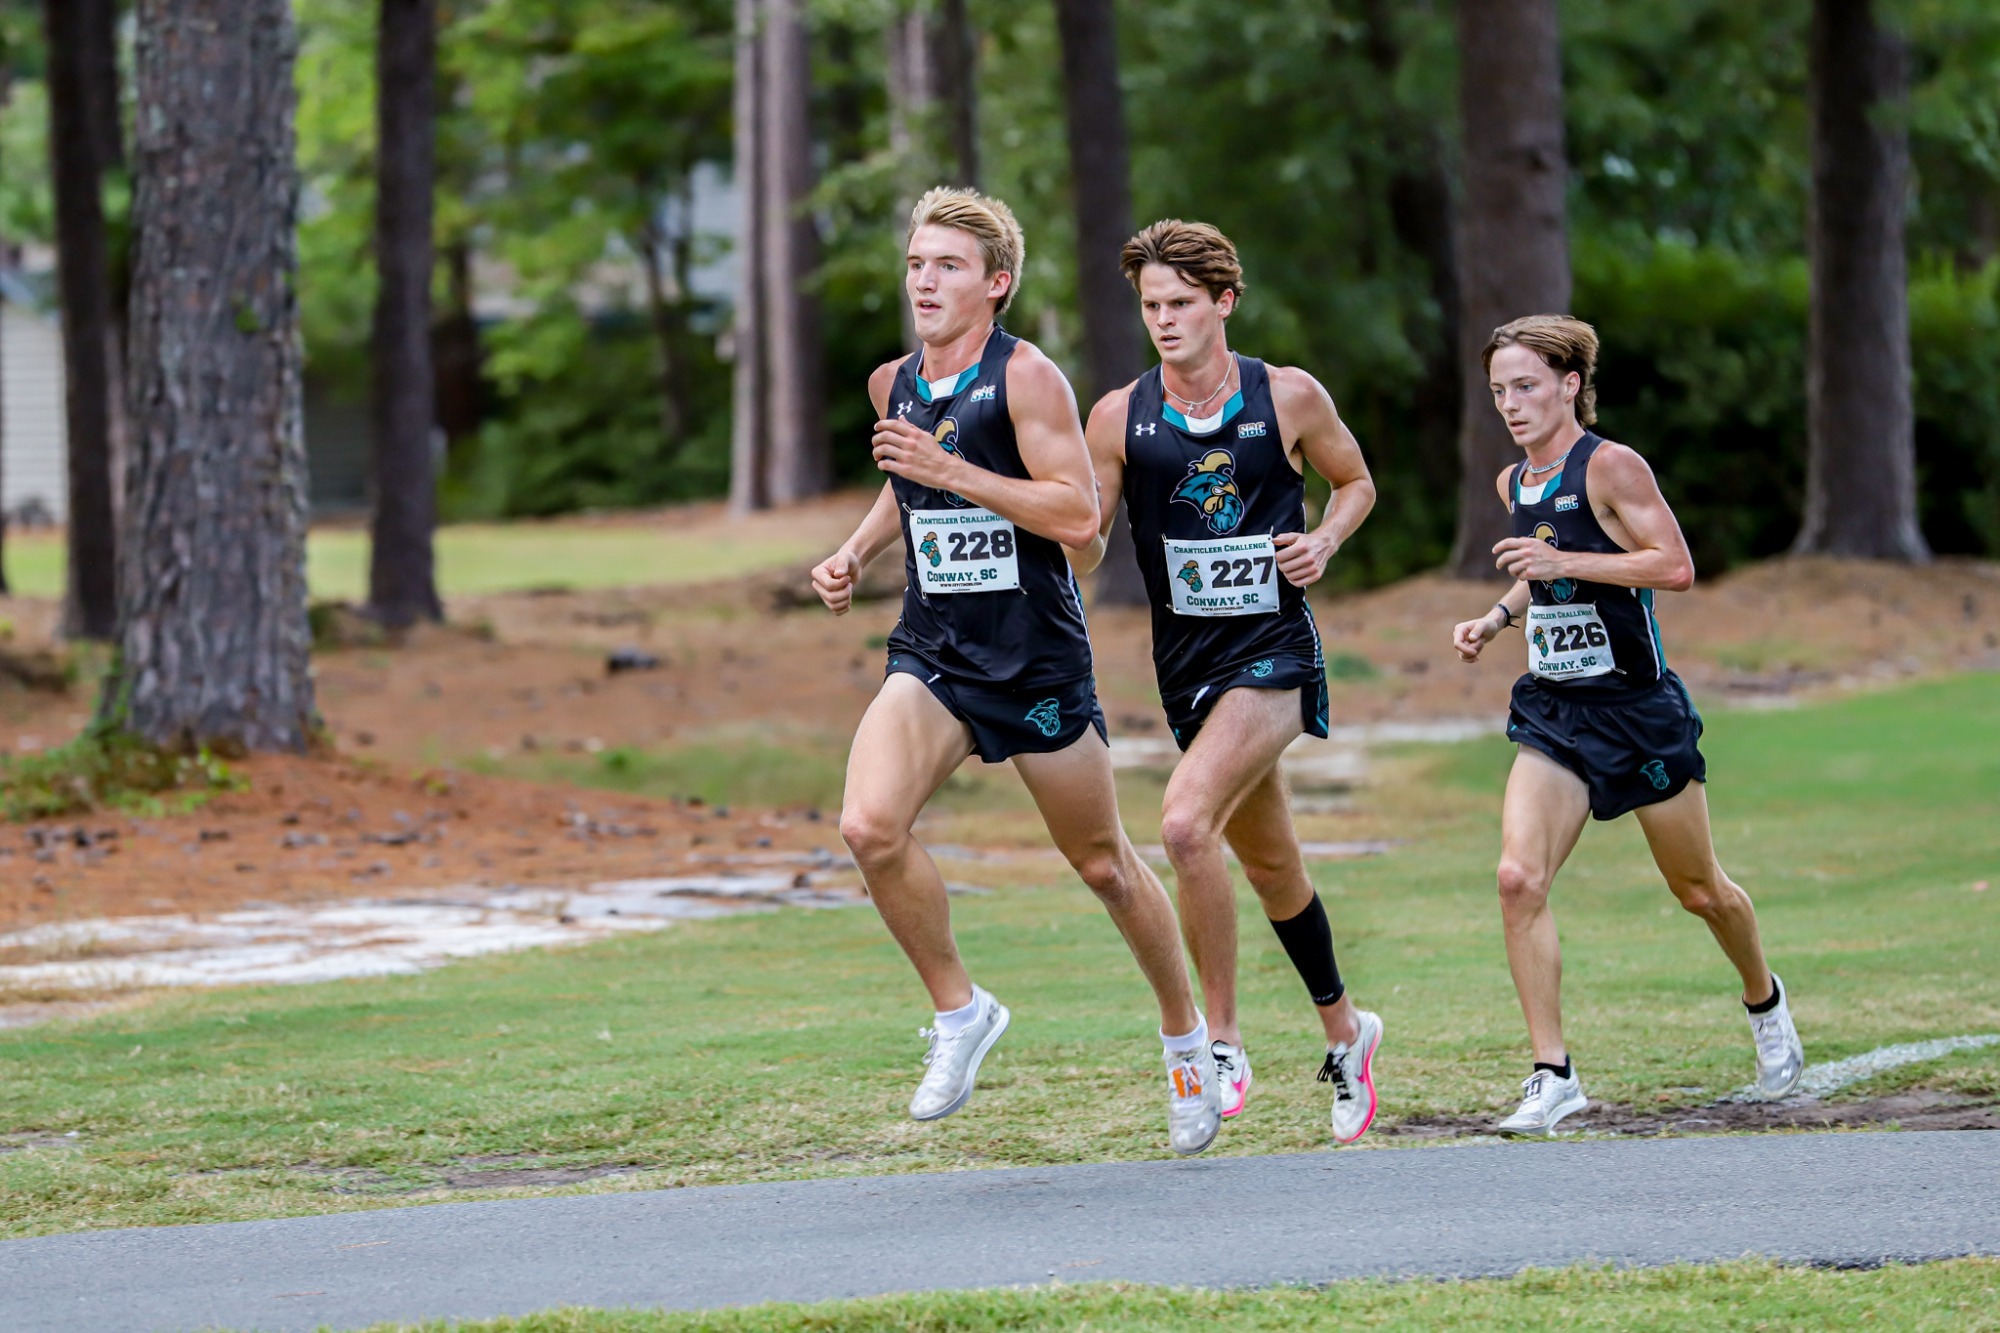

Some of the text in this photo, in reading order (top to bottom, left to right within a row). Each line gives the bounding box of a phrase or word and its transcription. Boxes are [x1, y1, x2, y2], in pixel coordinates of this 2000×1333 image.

[1238, 421, 1266, 438] SBC
[1555, 494, 1578, 512] SBC
[948, 529, 1014, 561] 228
[1174, 542, 1267, 554] CHANTICLEER CHALLENGE
[980, 568, 997, 580] SC
[1211, 556, 1274, 588] 227
[1242, 593, 1259, 604] SC
[1551, 622, 1606, 653] 226
[1580, 656, 1596, 666] SC
